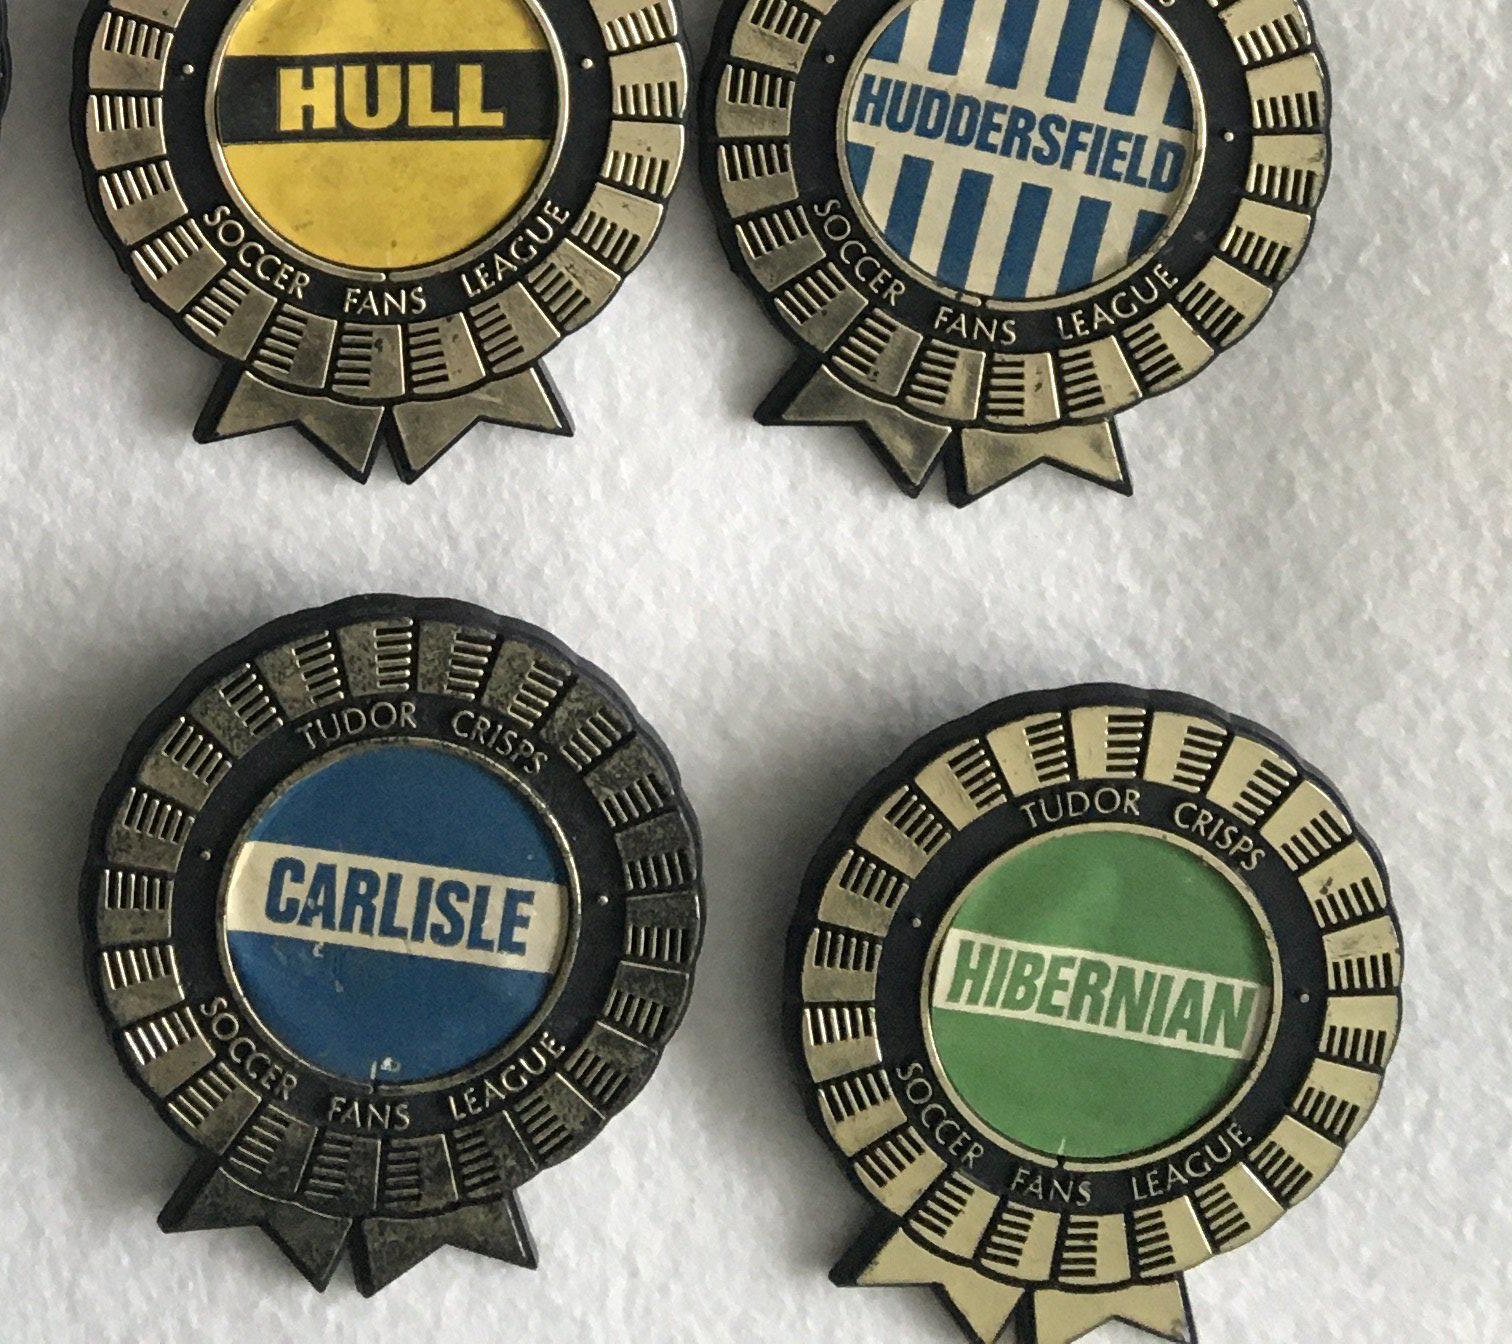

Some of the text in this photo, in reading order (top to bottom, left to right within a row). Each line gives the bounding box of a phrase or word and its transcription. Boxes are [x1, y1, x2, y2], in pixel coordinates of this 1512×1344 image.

[277, 62, 507, 132] HULL
[852, 73, 1187, 194] HUDDERSFIELD
[203, 199, 571, 316] SOCCER FANS LEAGUE
[813, 199, 1179, 345] SOCCER FANS LEAGUE
[297, 702, 549, 776] TUDOR CRISPS
[1019, 787, 1267, 873] TUDOR CRISPS
[264, 856, 536, 957] CARLISLE
[945, 938, 1258, 1051] HIBERNIAN
[199, 997, 568, 1130] SOCCER FANS LEAGUE
[896, 1062, 1254, 1207] SOCCER FANS LEAGUE
